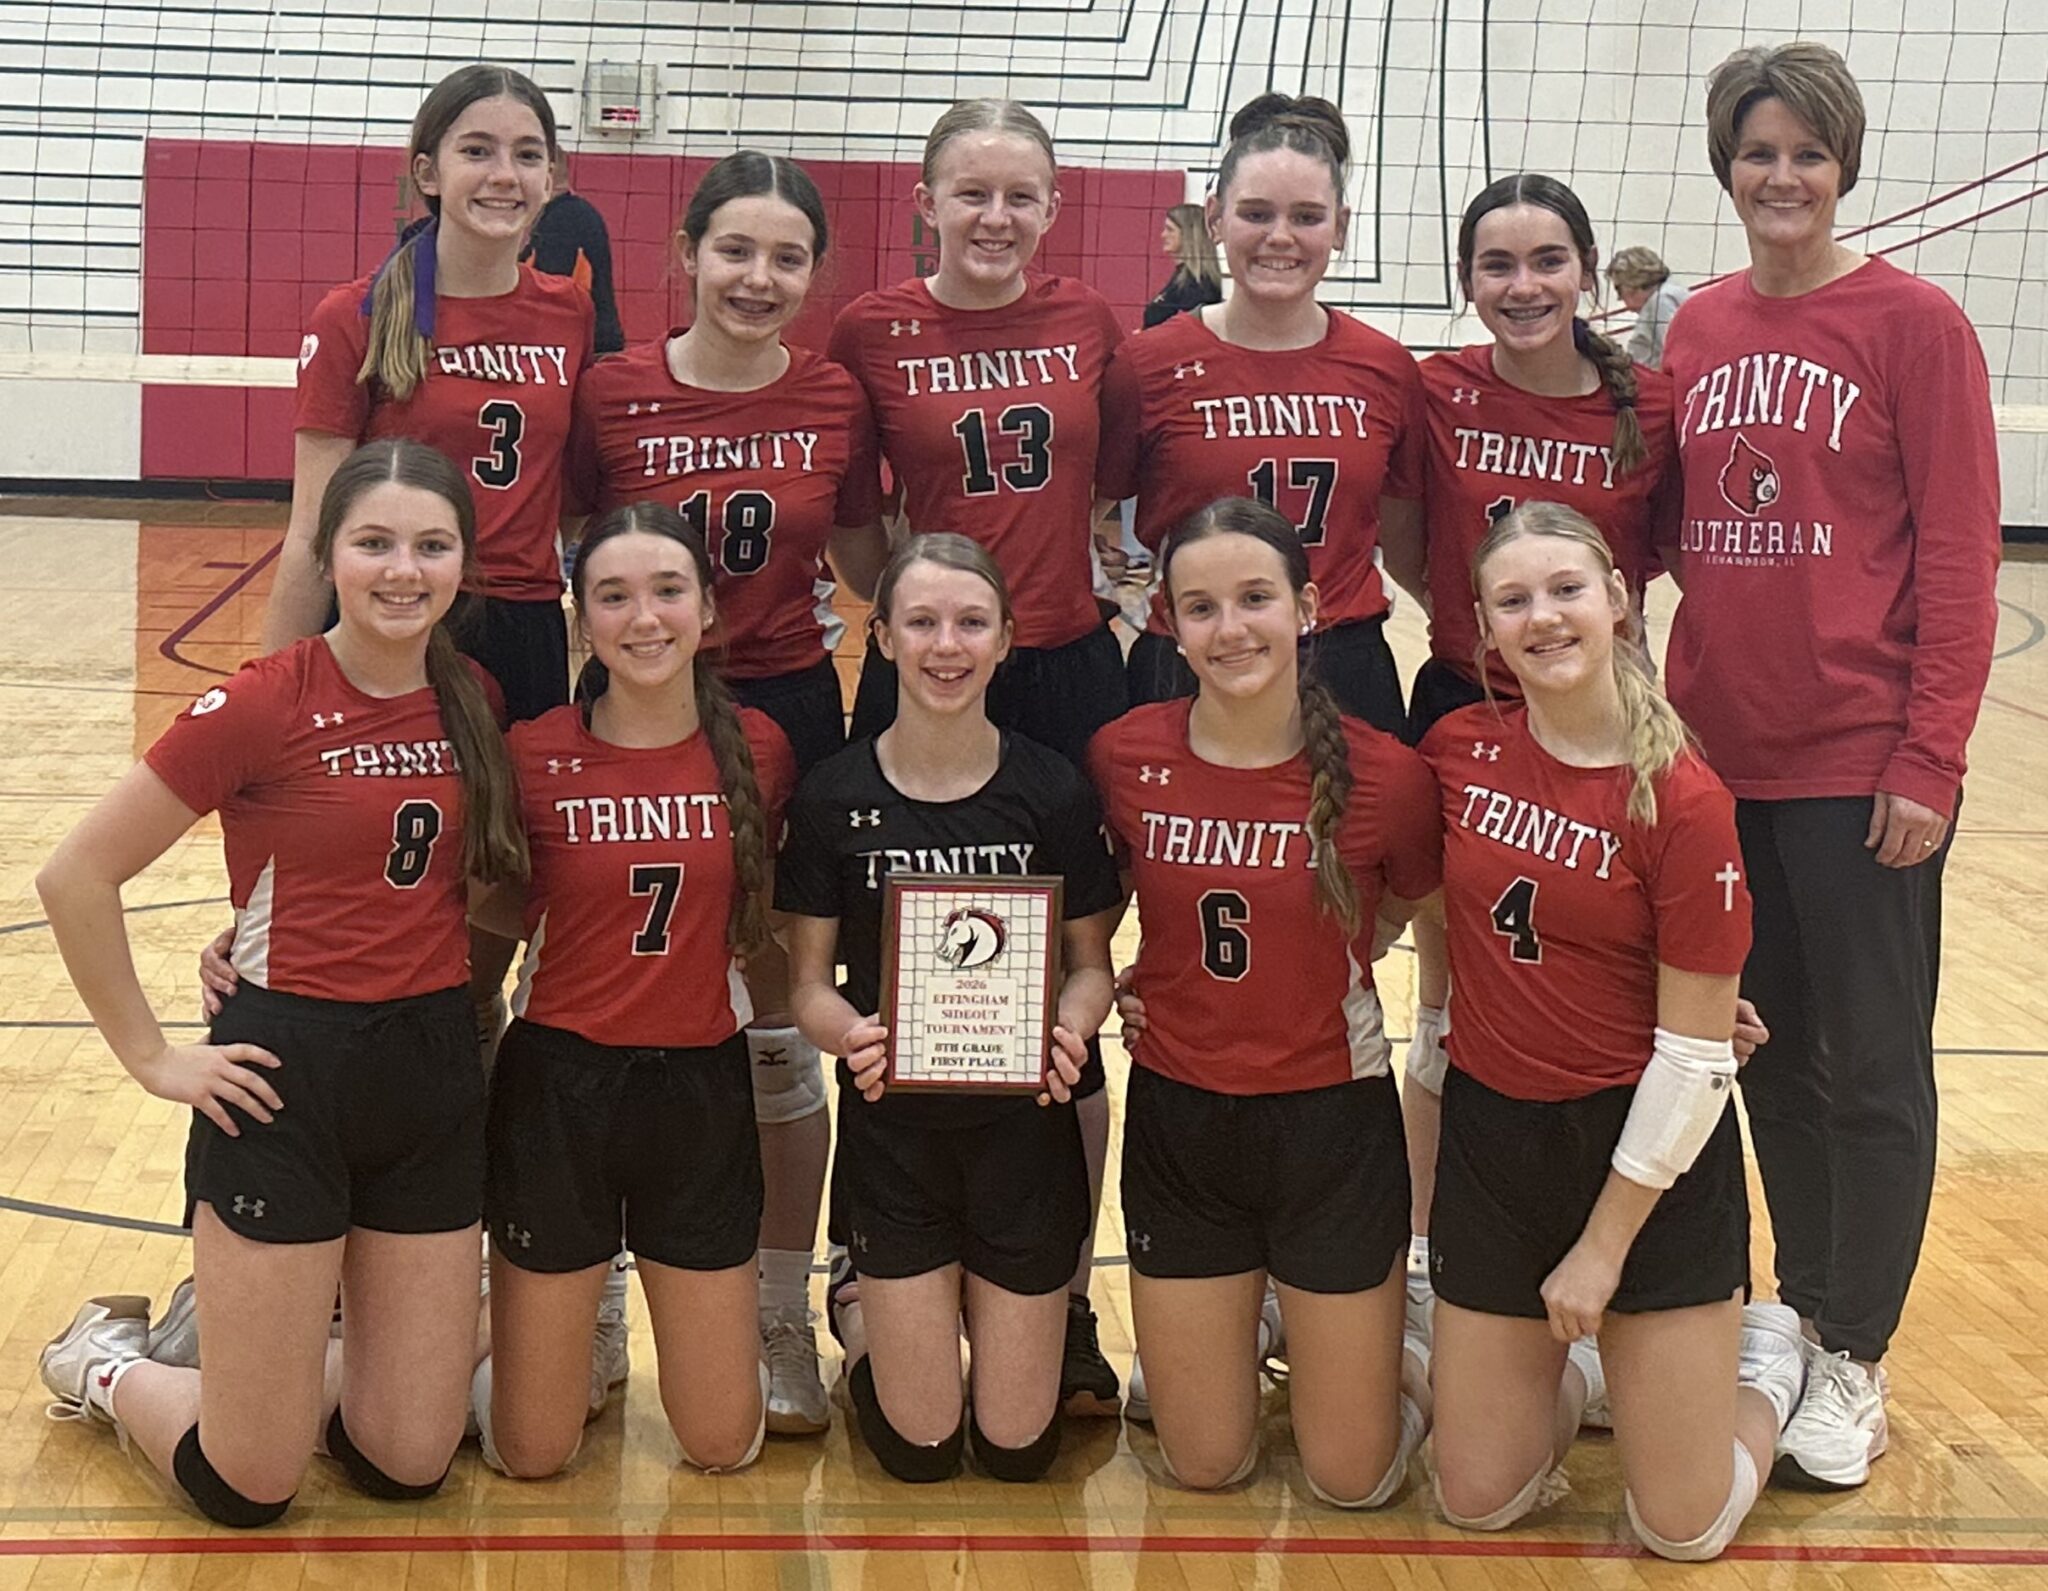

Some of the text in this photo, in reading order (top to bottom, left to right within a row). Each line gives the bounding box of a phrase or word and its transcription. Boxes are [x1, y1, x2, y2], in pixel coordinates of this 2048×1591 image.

[434, 344, 568, 386] RINITY
[897, 344, 1080, 395] TRINITY
[1193, 395, 1369, 439] TRINITY
[1680, 353, 1861, 453] TRINITY
[472, 399, 526, 491] 3
[637, 432, 819, 477] TRINITY
[953, 402, 1054, 497] 13
[1454, 428, 1620, 490] TRINITY
[1247, 457, 1339, 548] 17
[678, 489, 776, 576] 18
[1680, 520, 1833, 556] LUTHERAN
[555, 794, 735, 843] TRINIT
[1459, 784, 1622, 880] TRINITY
[383, 799, 443, 889] 8
[856, 844, 1034, 889] TRINITY
[629, 863, 685, 956] 7
[1490, 876, 1542, 965] 4
[1198, 889, 1252, 982] 6
[933, 994, 1009, 1006] EFFINGHAM
[955, 979, 987, 990] 2026
[924, 1023, 1016, 1035] TOURNAMENT
[941, 1009, 1000, 1020] SIDEOUT
[930, 1056, 1006, 1067] FIRST PLACE
[934, 1042, 1004, 1053] 8TH GRADE
